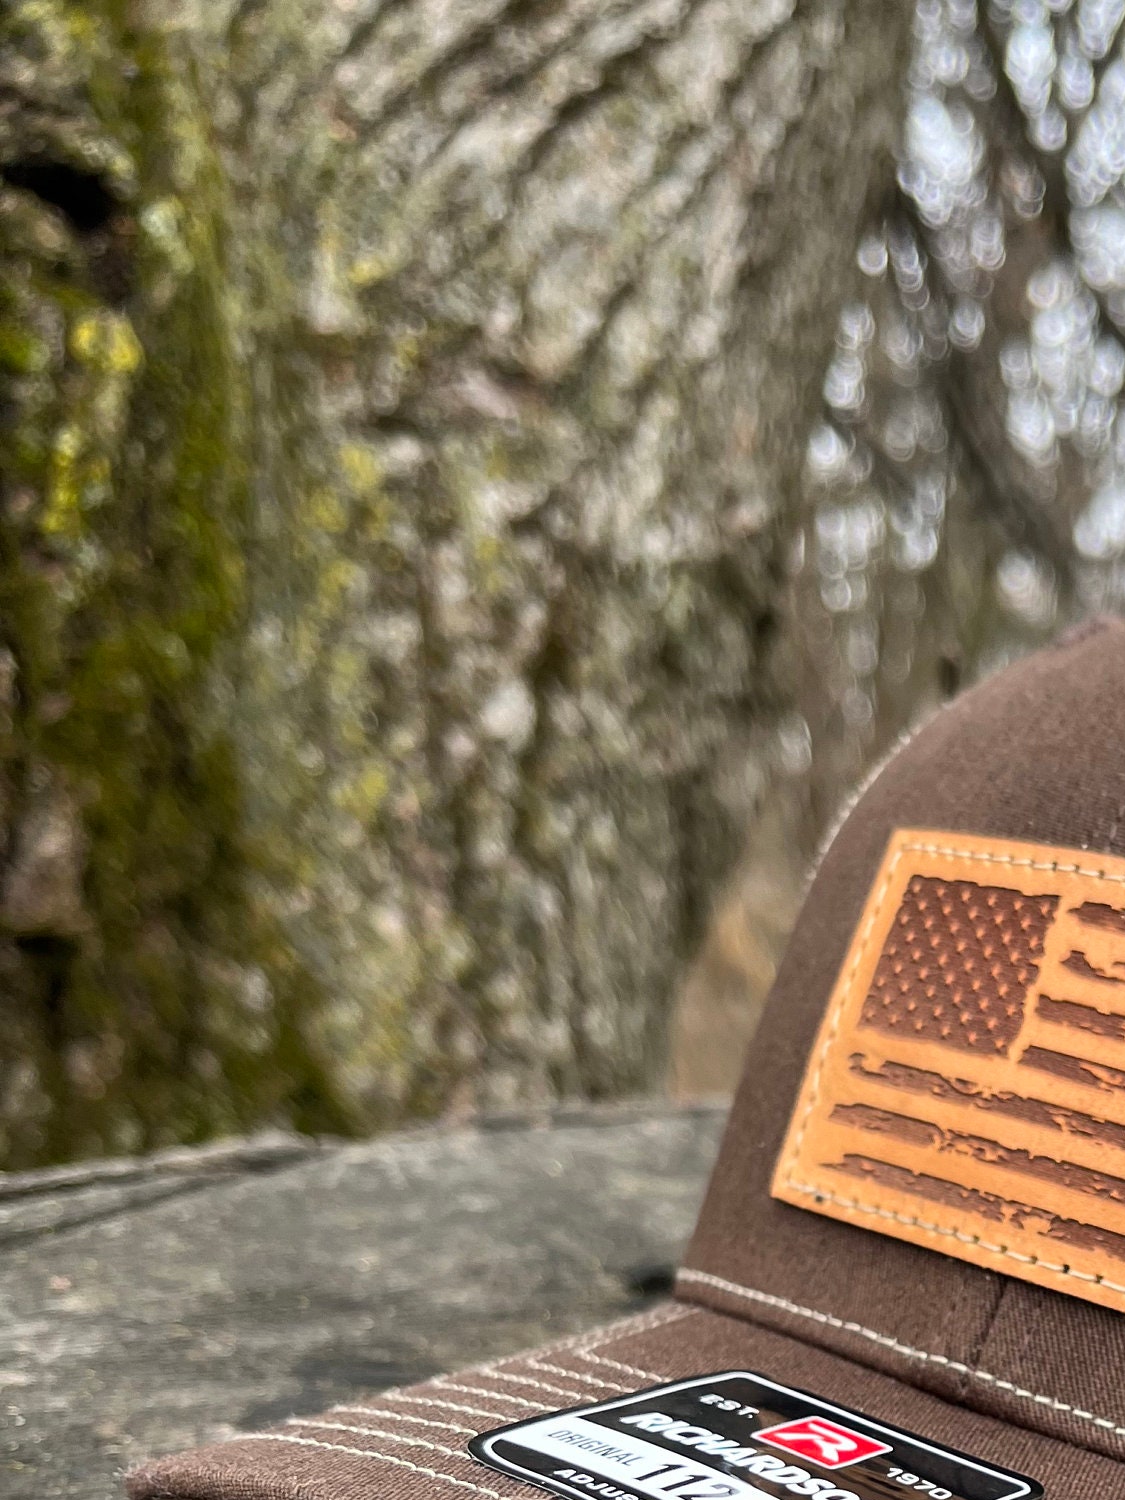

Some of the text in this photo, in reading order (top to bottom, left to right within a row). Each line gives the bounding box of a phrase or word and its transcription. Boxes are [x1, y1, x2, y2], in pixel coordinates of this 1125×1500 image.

[547, 1429, 645, 1468] ORIGINAL
[700, 1394, 953, 1500] EST. 1970
